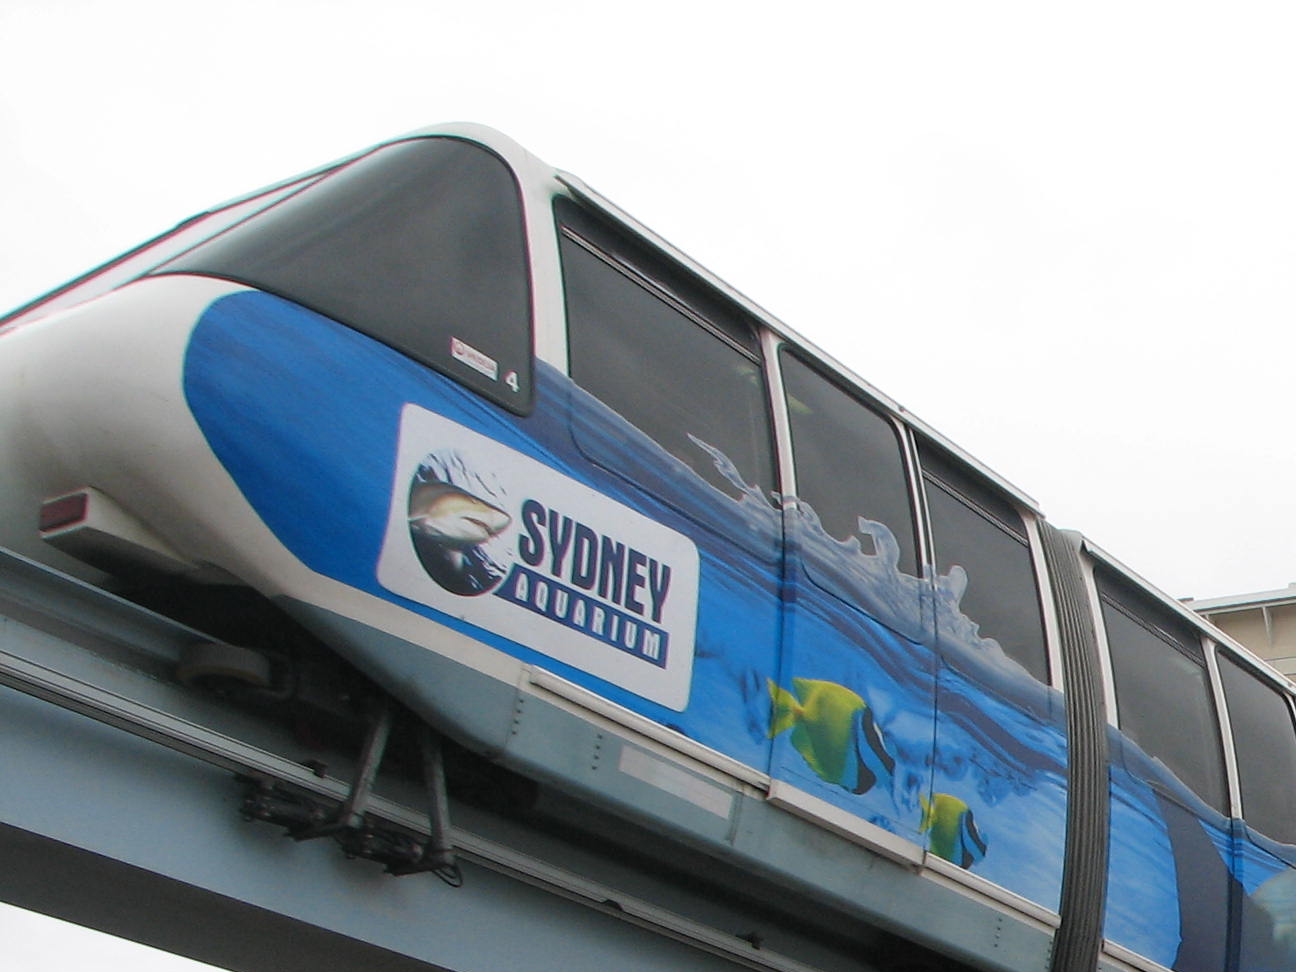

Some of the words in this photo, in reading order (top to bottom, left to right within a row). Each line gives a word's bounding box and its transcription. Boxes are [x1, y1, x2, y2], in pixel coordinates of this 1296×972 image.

[504, 370, 520, 393] 4
[518, 498, 672, 625] SYDNEY
[513, 571, 662, 660] AQUARIUM
